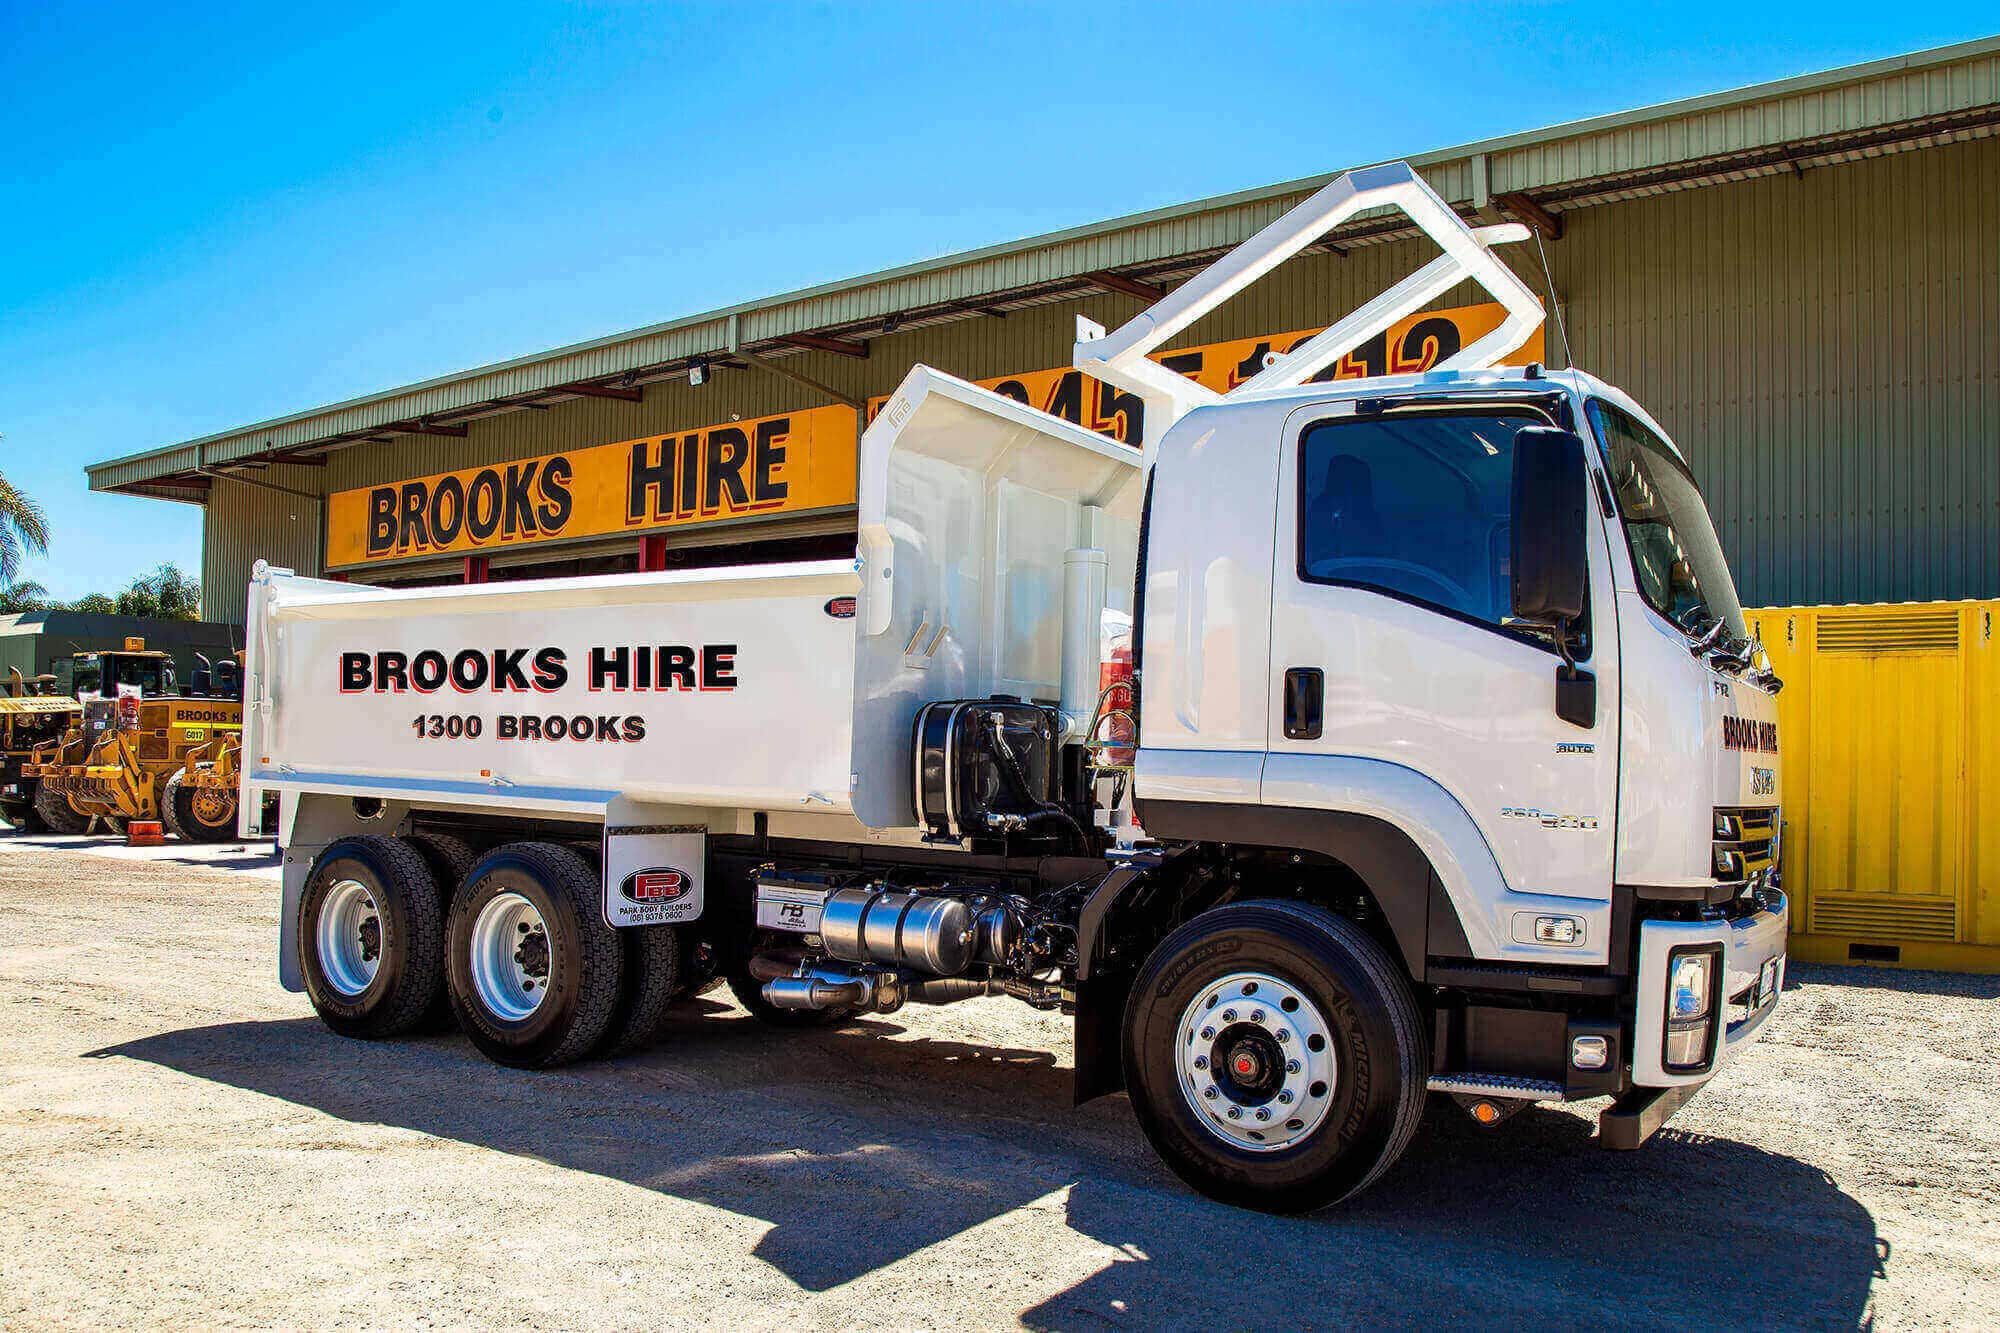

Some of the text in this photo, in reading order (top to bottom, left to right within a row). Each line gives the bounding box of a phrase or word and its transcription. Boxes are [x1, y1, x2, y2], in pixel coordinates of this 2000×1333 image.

[366, 418, 791, 559] BROOKS HIRE
[339, 643, 739, 694] BROOKS HIRE
[176, 709, 228, 722] BROOKS
[412, 714, 647, 742] 1300 BROOKS
[1723, 715, 1778, 755] BROOKS HIRE
[1342, 1030, 1371, 1139] MICHELIN
